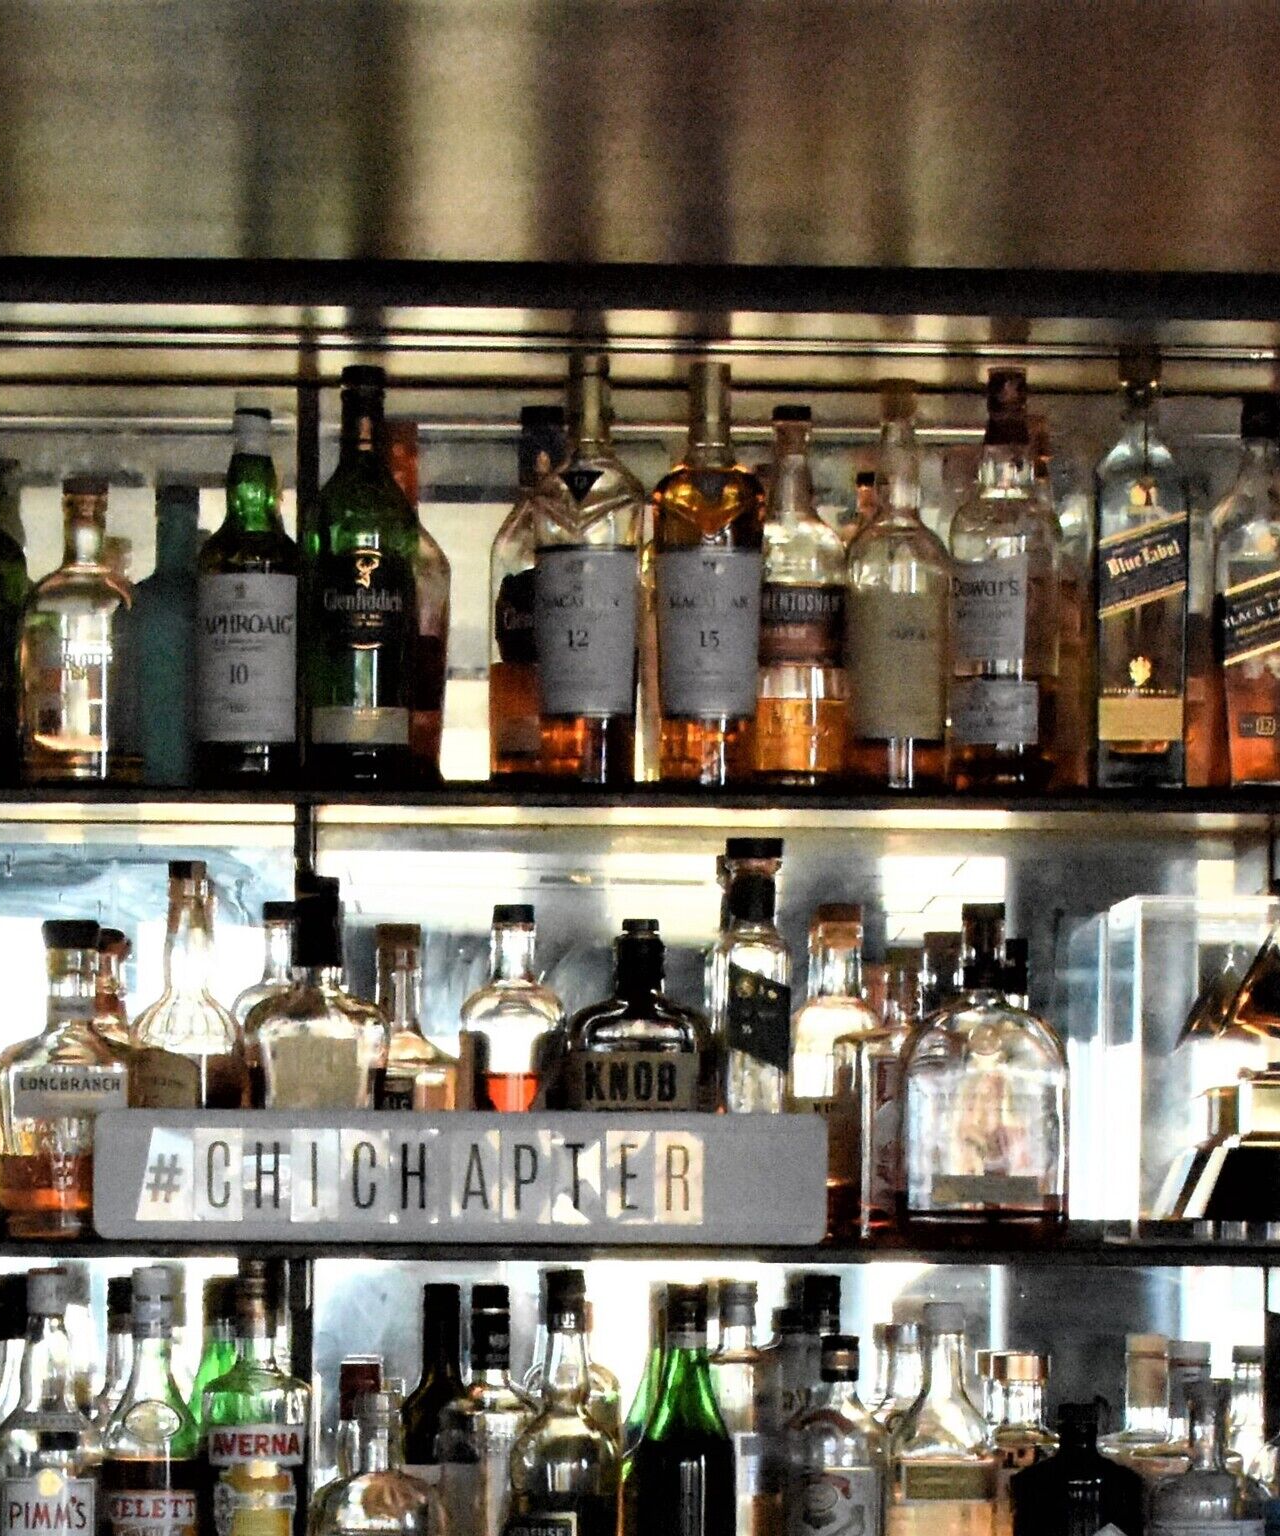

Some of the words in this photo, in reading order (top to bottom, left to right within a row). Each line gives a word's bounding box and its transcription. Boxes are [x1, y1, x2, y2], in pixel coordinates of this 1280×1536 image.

[1107, 552, 1142, 578] Blue
[1143, 540, 1180, 566] Label
[567, 630, 590, 648] 12
[699, 630, 721, 648] 15
[229, 663, 250, 685] 10
[20, 1077, 120, 1092] LONGBRANCH
[584, 1060, 677, 1102] KNOB
[212, 1433, 301, 1457] AVERNA
[9, 1495, 88, 1530] PIMM'S
[112, 1498, 197, 1520] ELETT
